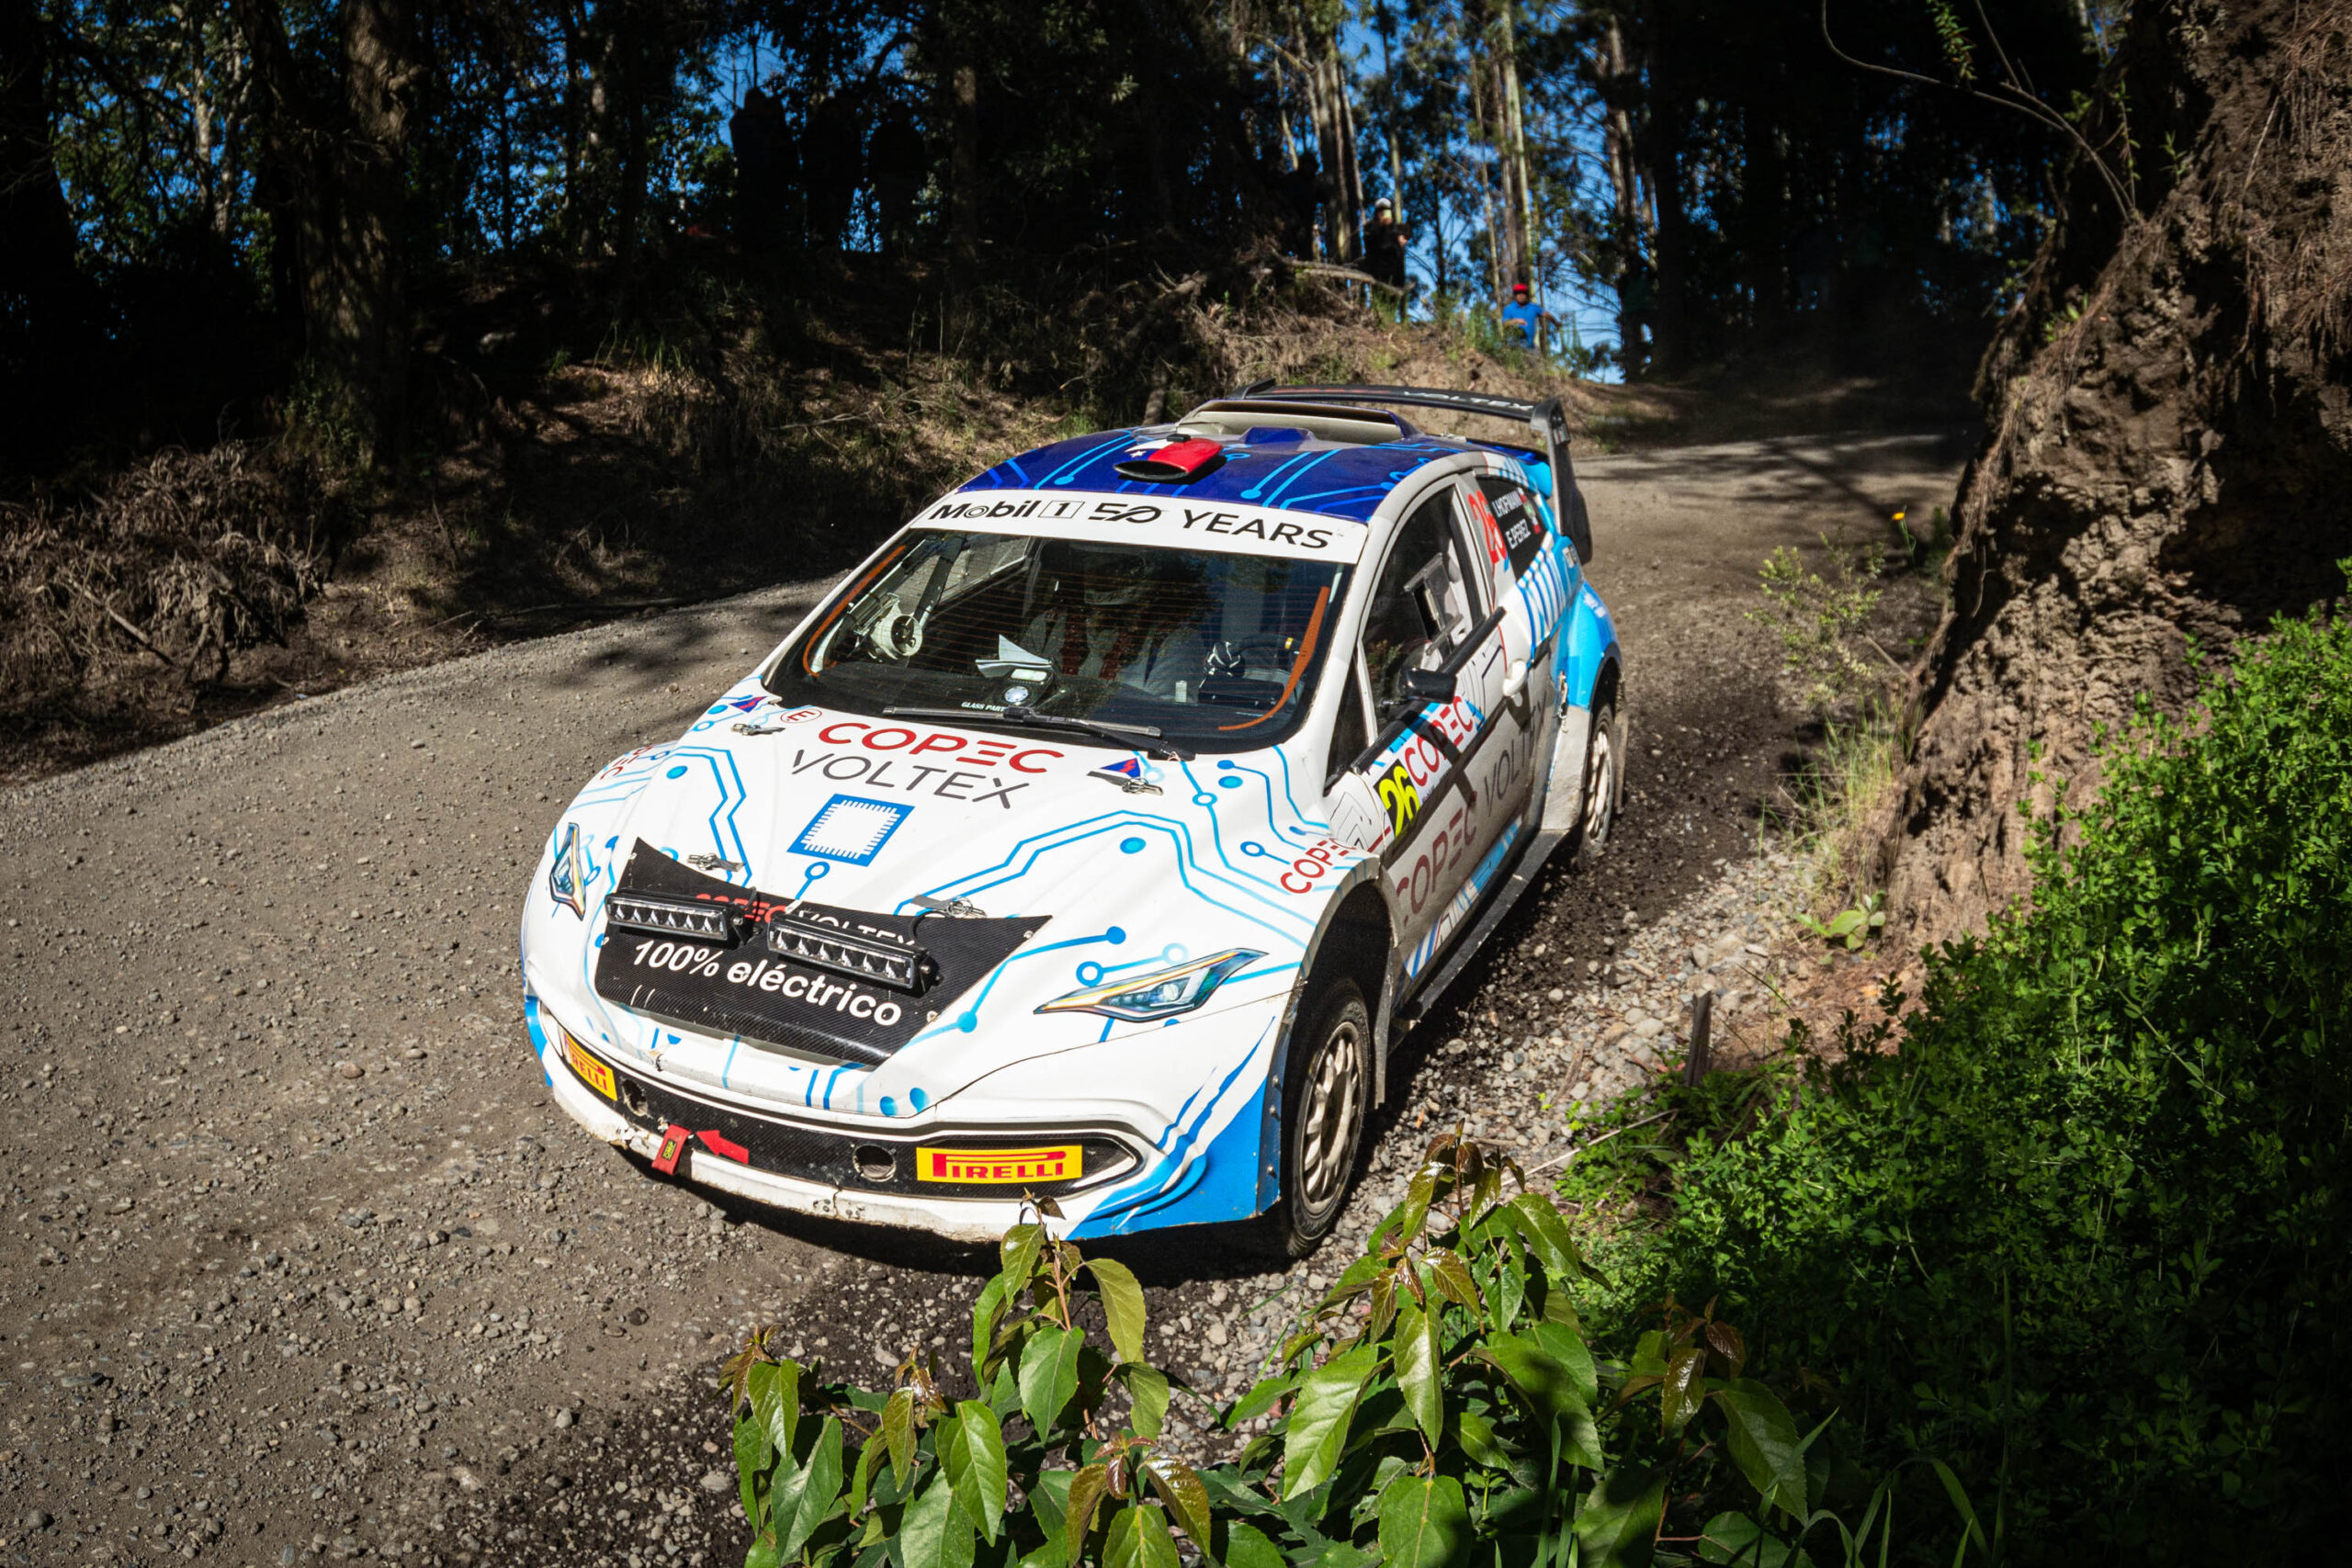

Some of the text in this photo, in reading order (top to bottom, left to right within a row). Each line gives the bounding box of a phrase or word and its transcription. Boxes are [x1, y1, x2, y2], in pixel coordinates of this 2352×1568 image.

[928, 500, 1042, 520] Mobil
[1088, 502, 1162, 525] 50
[1182, 509, 1334, 548] YEARS
[1467, 489, 1508, 565] 26
[961, 701, 985, 710] GLASS
[819, 723, 1065, 773] COPEC
[791, 749, 1030, 809] VOLTEX
[1379, 765, 1420, 843] 26
[633, 940, 901, 1026] 100% eléctrico
[563, 1032, 607, 1090] PRELLI
[933, 1151, 1067, 1179] PIRELLI
